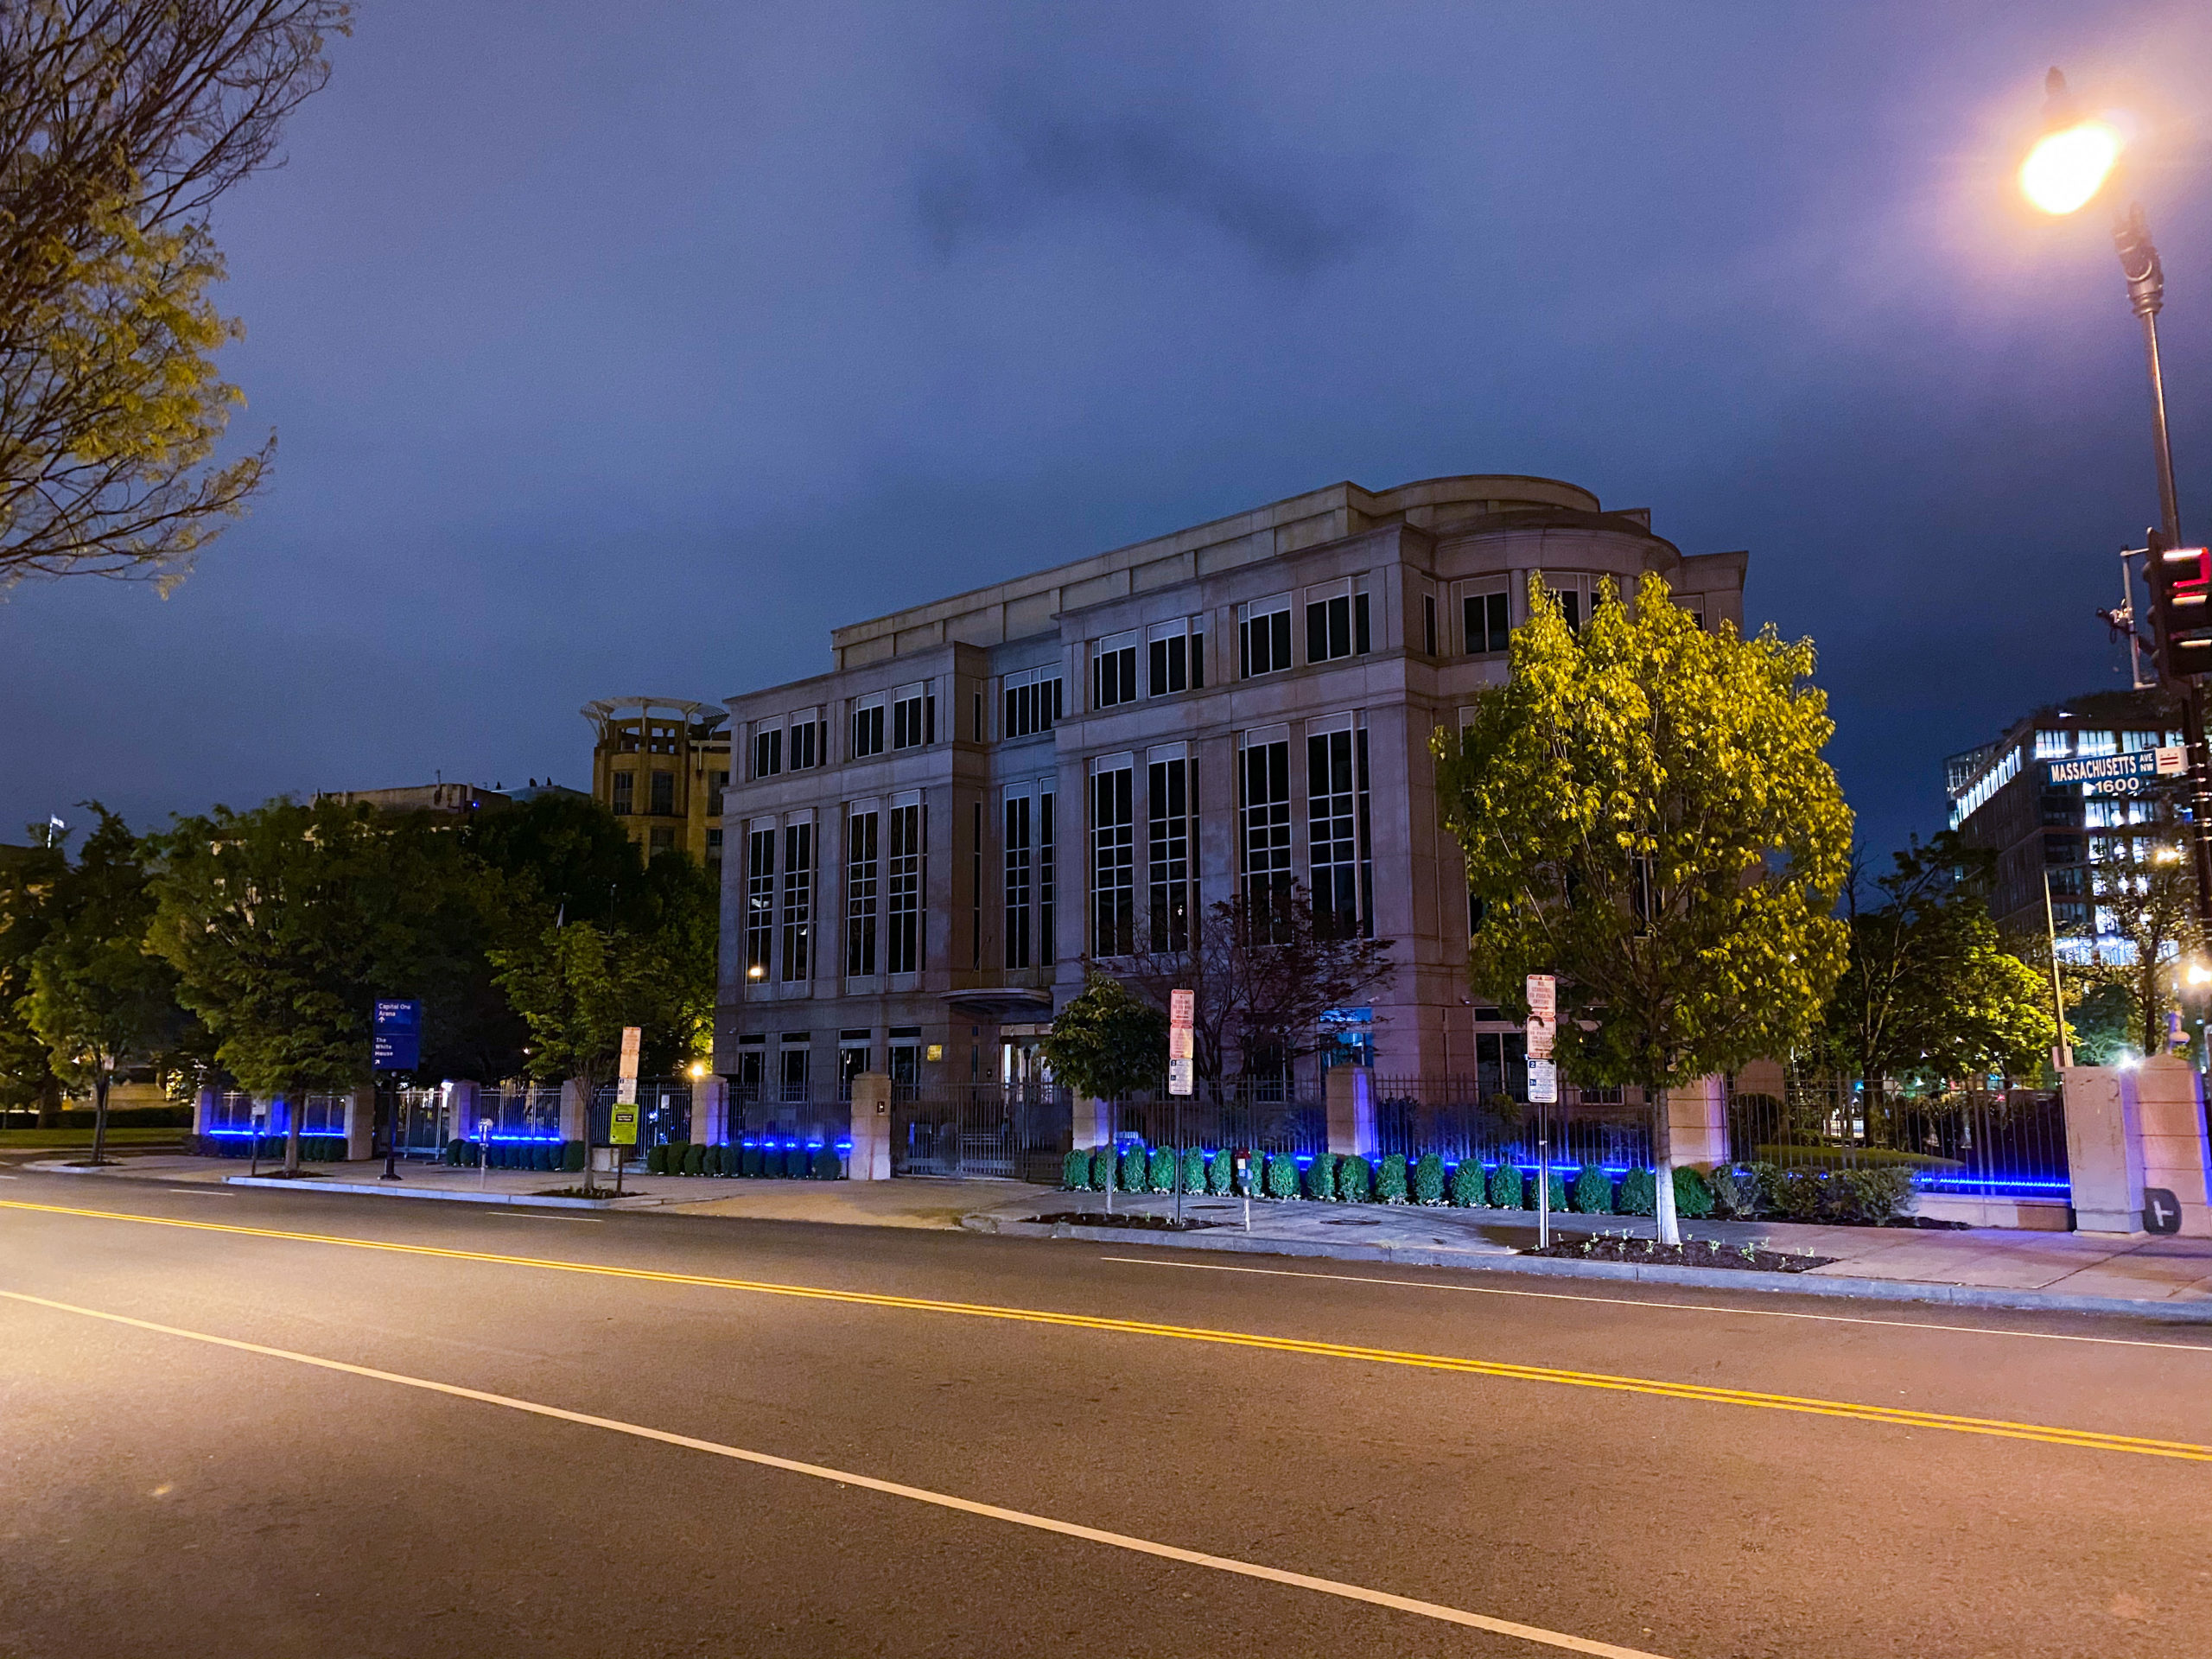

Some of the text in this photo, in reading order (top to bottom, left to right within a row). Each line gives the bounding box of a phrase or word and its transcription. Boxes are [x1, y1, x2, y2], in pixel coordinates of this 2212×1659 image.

[2139, 753, 2153, 762] AVE
[2050, 756, 2137, 783] MASSACHUSETTS
[2139, 763, 2154, 772] NW
[2094, 777, 2139, 793] 1600
